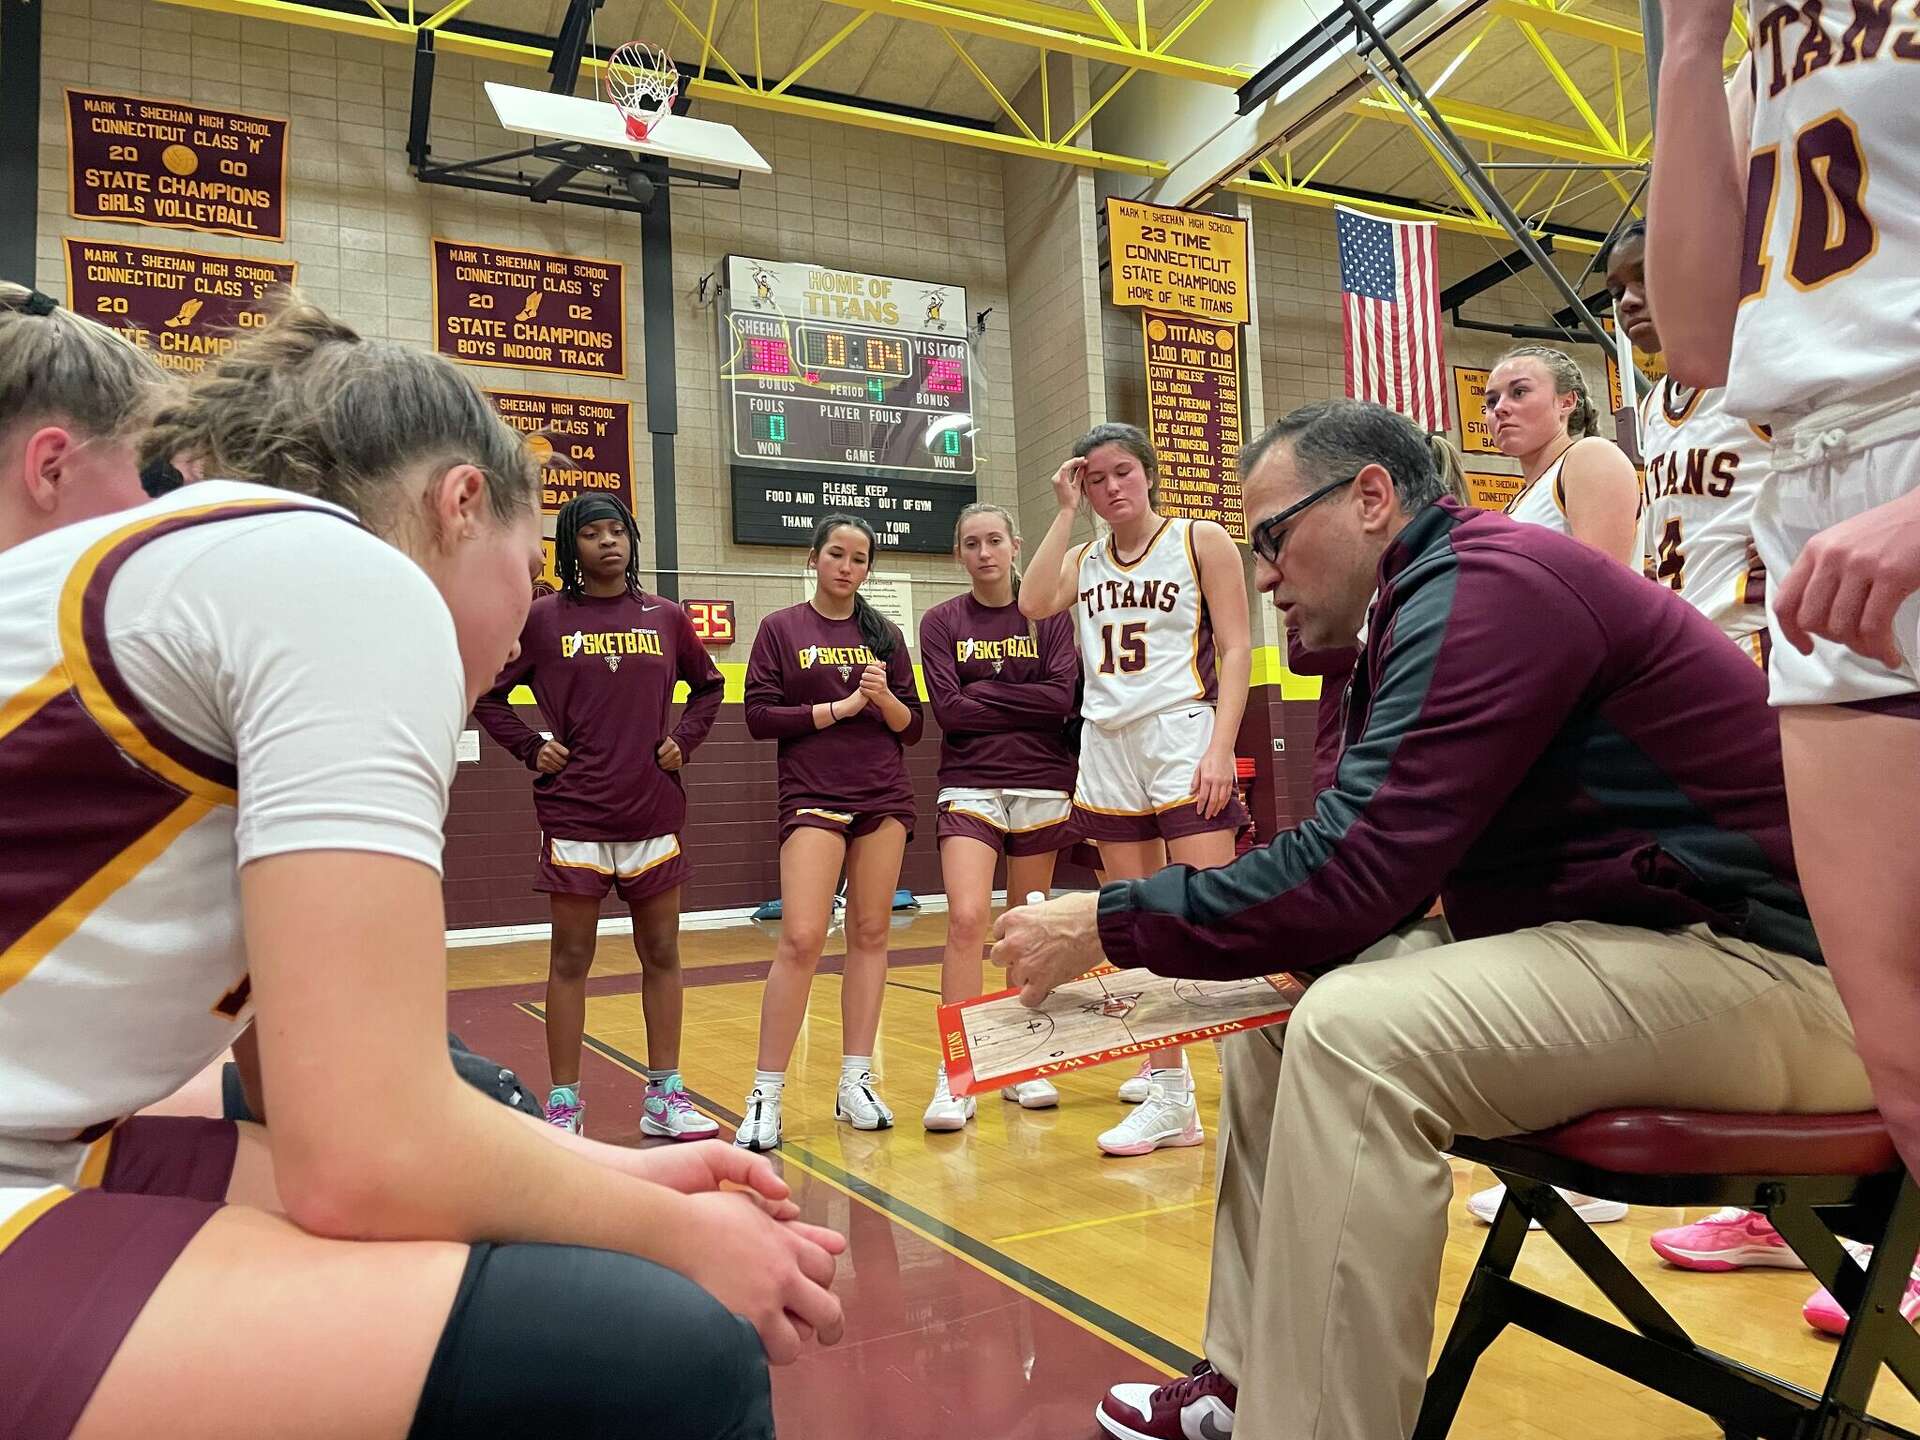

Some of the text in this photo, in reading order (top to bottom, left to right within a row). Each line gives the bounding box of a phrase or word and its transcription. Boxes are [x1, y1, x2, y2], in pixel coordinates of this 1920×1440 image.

[84, 100, 271, 137] MARK T. SHEEHAN HIGH SCHOOL
[92, 118, 186, 143] CONNECTICUT
[193, 131, 239, 150] CLASS
[109, 145, 248, 177] 20 00
[85, 168, 270, 208] STATE CHAMPIONS
[98, 193, 258, 229] GIRLS VOLLEYBALL
[1119, 206, 1140, 218] MARK
[1152, 213, 1185, 226] SHEEHAN
[1188, 218, 1204, 230] HIGH
[1208, 221, 1235, 235] SCHOOL
[1141, 225, 1211, 250] 23 TIME
[84, 248, 278, 283] MARK T. SHEEHAN HIGH SCHOOL
[449, 249, 609, 280] MARK T. SHEEHAN HIGH SCHOOL
[1126, 244, 1231, 274] CONNECTICUT
[87, 265, 186, 291] CONNECTICUT
[194, 278, 242, 297] CLASS
[456, 266, 537, 289] CONNECTICUT
[543, 277, 582, 295] CLASS
[809, 271, 893, 299] HOME OF
[1122, 266, 1236, 295] STATE CHAMPIONS
[97, 296, 129, 314] 20
[468, 293, 593, 321] 20 02
[803, 292, 900, 326] TITANS
[1128, 286, 1233, 313] HOME OF THE TITANS
[160, 331, 233, 357] CHAMP
[447, 317, 613, 349] STATE CHAMPIONS
[1168, 325, 1215, 346] TITANS
[457, 338, 605, 367] BOYS INDOOR TRACK
[914, 340, 964, 359] VISITOR
[1152, 344, 1177, 362] 1,000
[1210, 352, 1233, 370] CLUB
[759, 377, 796, 392] BONUS
[1150, 367, 1174, 379] CATHY
[830, 384, 864, 398] PERIOD
[868, 378, 883, 402] 4
[1152, 381, 1168, 392] LISA
[500, 399, 616, 420] SHEEHAN HIGH SCHOOL
[750, 398, 785, 413] FOULS
[916, 392, 950, 407] BONUS
[1153, 395, 1177, 407] JASON
[1179, 397, 1211, 411] FREEMAN
[819, 405, 902, 424] PLAYER FOULS
[1154, 408, 1173, 420] TARA
[551, 418, 589, 435] CLASS
[769, 415, 785, 441] 0
[1155, 422, 1169, 434] JOE
[1171, 424, 1204, 437] GAETANO
[1467, 422, 1488, 434] STAT
[570, 445, 595, 460] 04
[757, 442, 782, 456] WON
[944, 430, 961, 455] 0
[1155, 437, 1170, 448] JAY
[845, 449, 876, 464] GAME
[933, 456, 956, 469] WON
[541, 468, 621, 490] HAMPIONS
[1158, 464, 1174, 476] PHIL
[1177, 466, 1210, 478] GAETANO
[1645, 448, 1740, 505] ITANS
[765, 490, 791, 504] FOOD
[795, 493, 815, 505] AND
[823, 494, 871, 508] EVERAGES
[878, 497, 897, 509] OUT
[822, 482, 888, 498] PLEASE KEEP
[1160, 492, 1182, 504] OLIVIA
[1184, 494, 1213, 506] ROBLES
[1479, 492, 1514, 503] CONNECTI
[781, 515, 911, 534] THANK YOUR
[875, 532, 899, 545] TION
[1657, 516, 1686, 592] 4
[1080, 580, 1181, 619] TITANS
[689, 604, 732, 638] 35
[561, 631, 663, 658] BSKETBALL
[956, 637, 1040, 663] BSKETBALL
[1099, 621, 1148, 675] 15
[799, 645, 877, 669] BSKETBA
[1034, 1021, 1245, 1076] WILL FINDS A WAY
